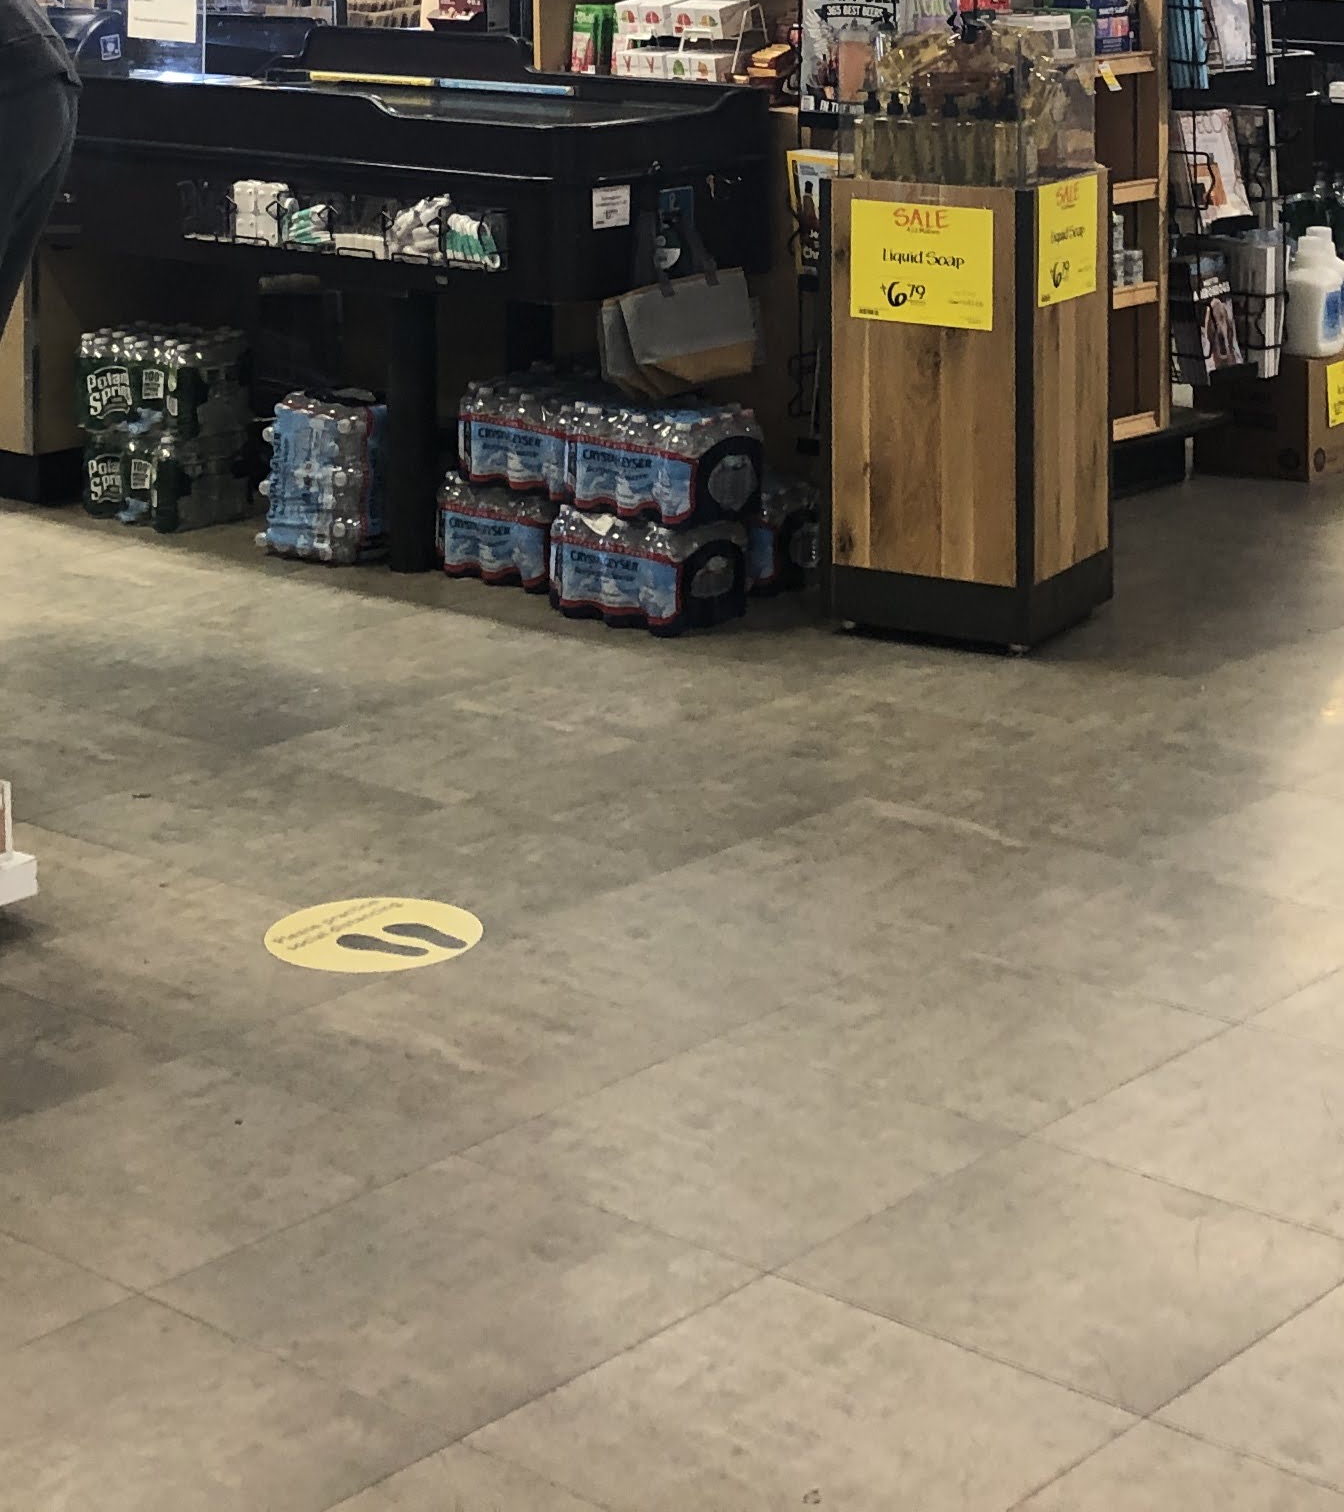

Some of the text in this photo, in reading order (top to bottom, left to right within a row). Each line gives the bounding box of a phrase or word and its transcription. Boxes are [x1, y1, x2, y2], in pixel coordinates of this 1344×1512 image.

[827, 5, 841, 16] 365
[843, 5, 860, 16] BEST
[1056, 182, 1080, 204] SALE
[893, 207, 950, 230] SALE
[882, 248, 965, 271] Liquid Soap
